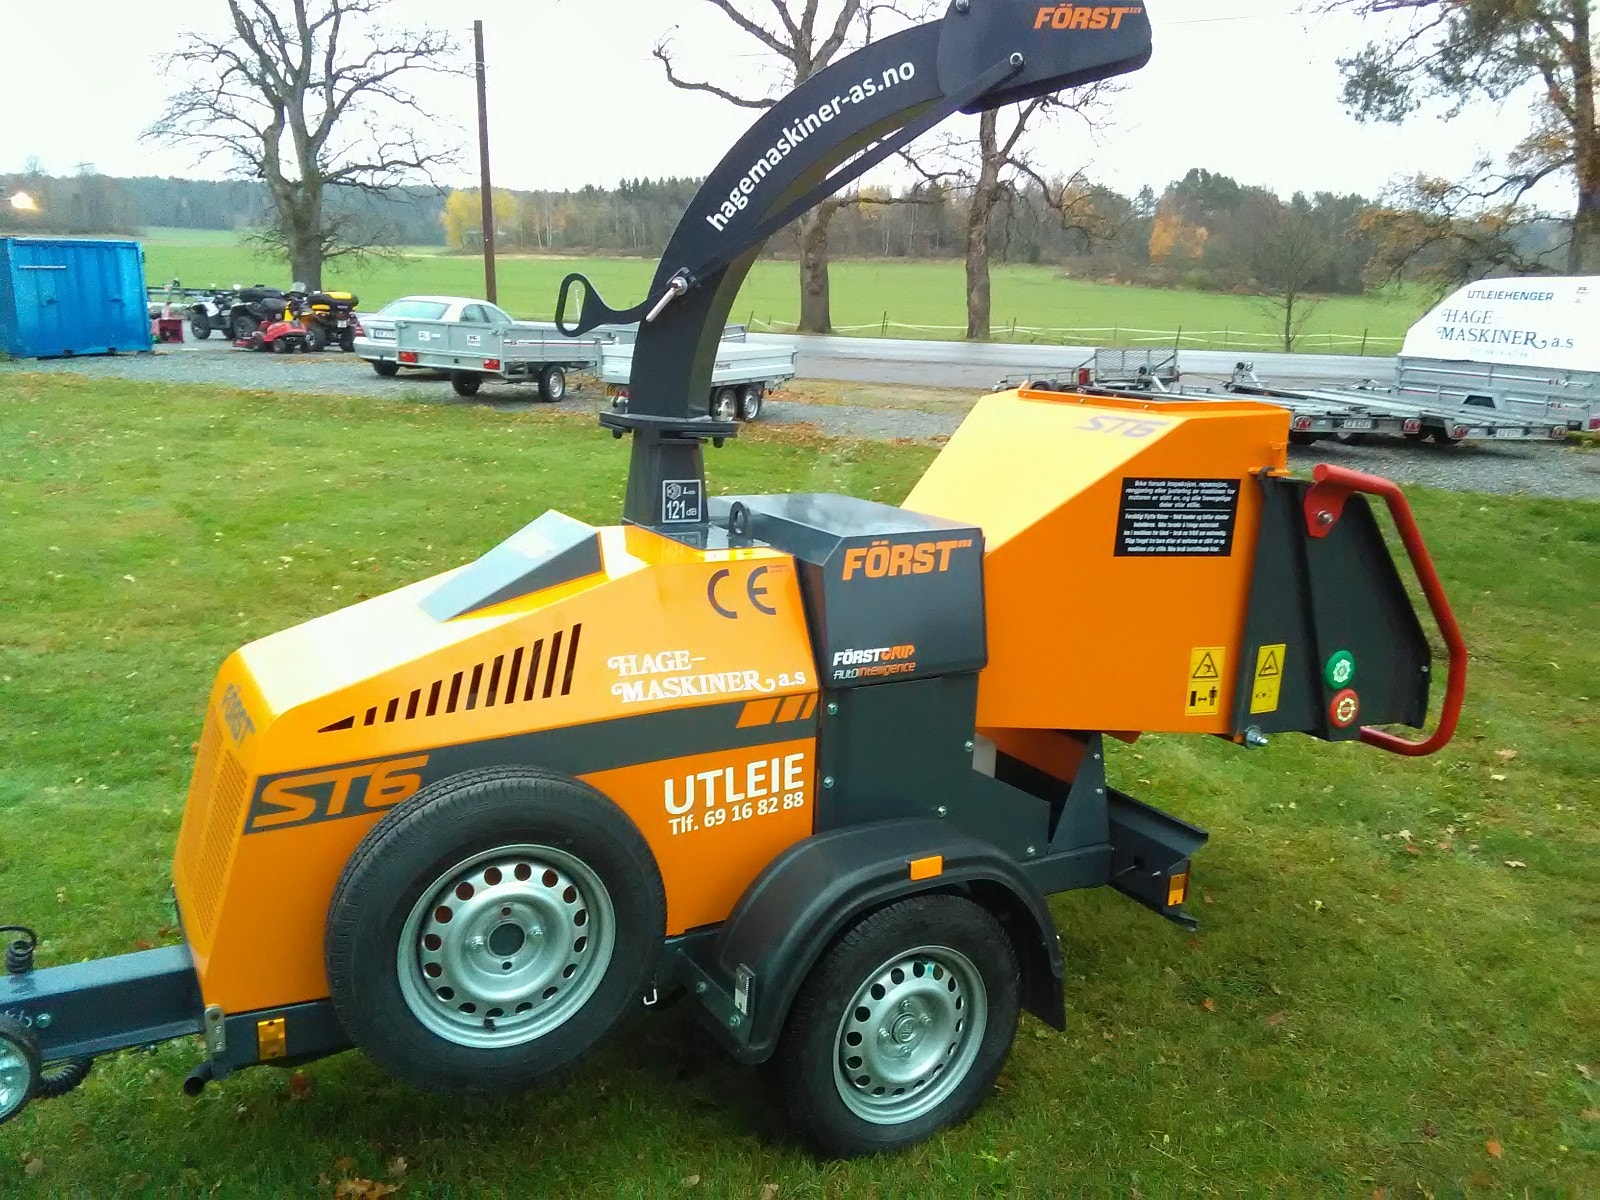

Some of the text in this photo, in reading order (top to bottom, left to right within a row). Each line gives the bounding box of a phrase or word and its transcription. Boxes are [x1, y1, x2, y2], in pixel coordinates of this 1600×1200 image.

[1034, 3, 1142, 30] FÖRST
[706, 60, 916, 232] hagemaskiner-as.no
[1467, 290, 1554, 301] UTLEIEHENGER
[1436, 326, 1574, 349] MASKINER a.s
[667, 500, 686, 519] 121
[842, 539, 973, 580] FÖRST
[611, 670, 807, 704] MASKINER a.s
[252, 754, 430, 829] ST6
[664, 752, 805, 815] UTLEIE
[668, 791, 805, 836] Tlf. 69 16 82 88
